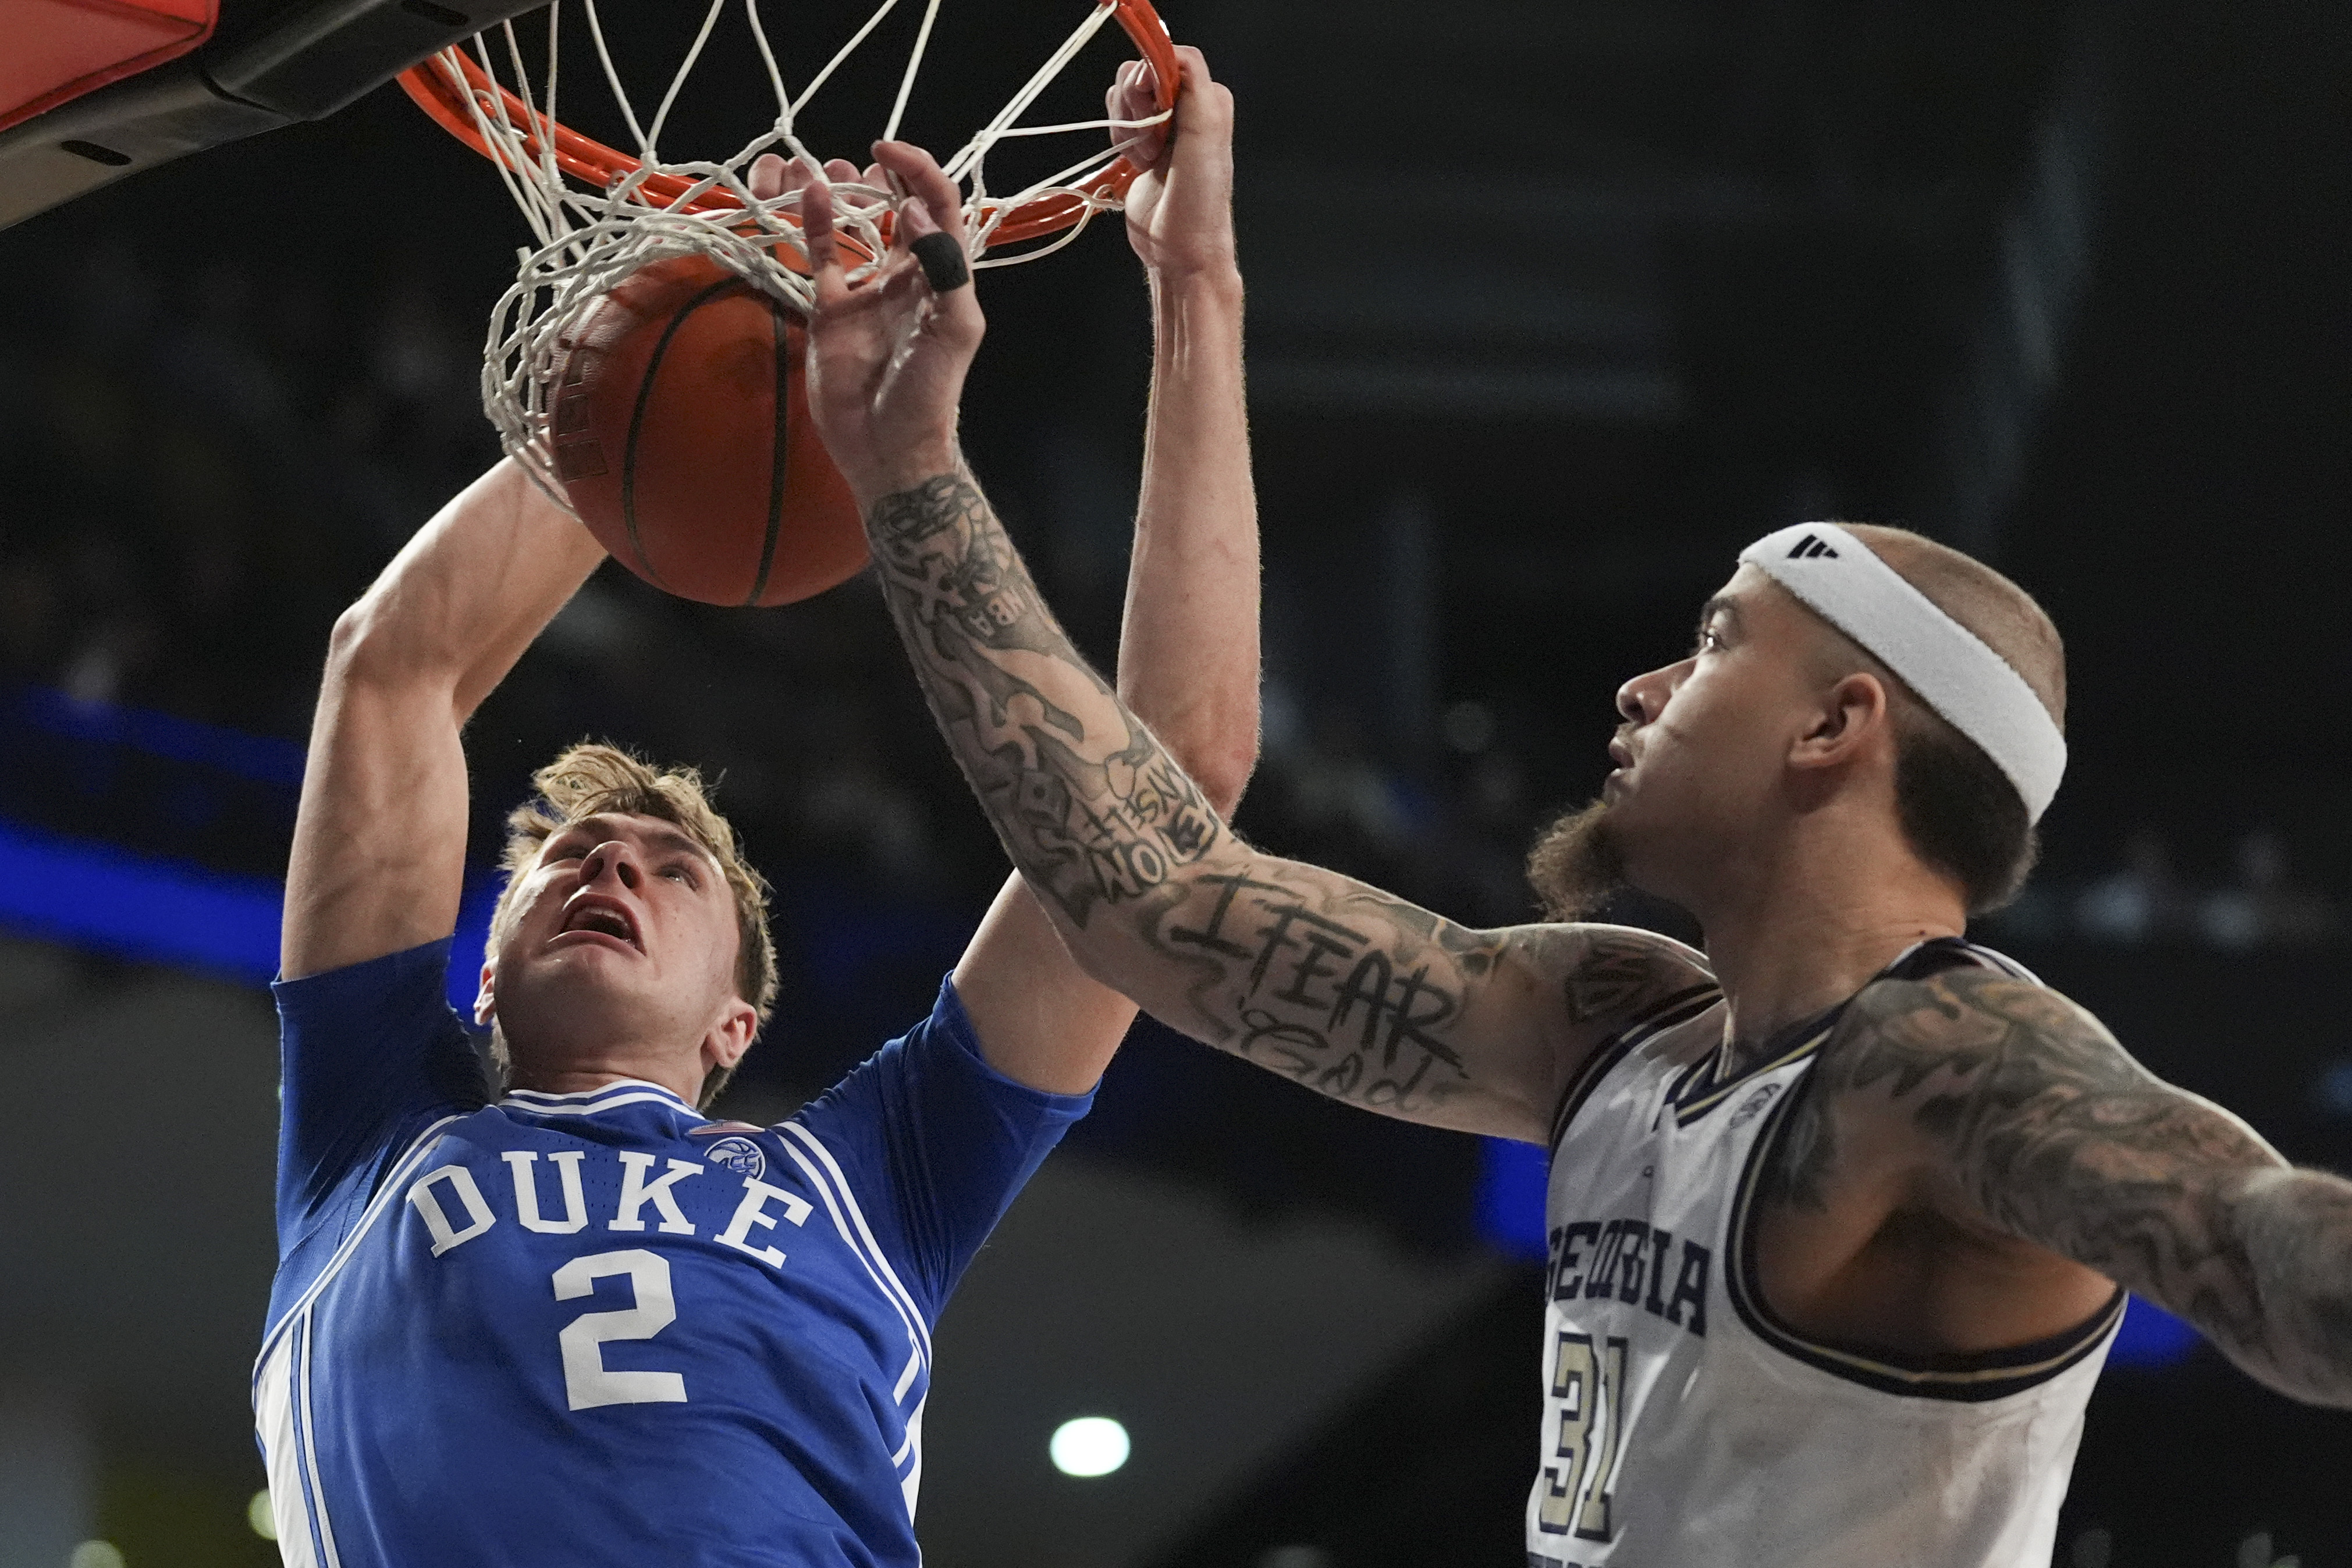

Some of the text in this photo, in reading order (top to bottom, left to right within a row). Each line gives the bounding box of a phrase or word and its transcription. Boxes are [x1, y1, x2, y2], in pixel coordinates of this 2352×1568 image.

[1250, 901, 1470, 1079] FEAR
[406, 1150, 813, 1270] DUKE
[552, 1249, 688, 1411] 2
[1539, 1331, 1628, 1543] 31
